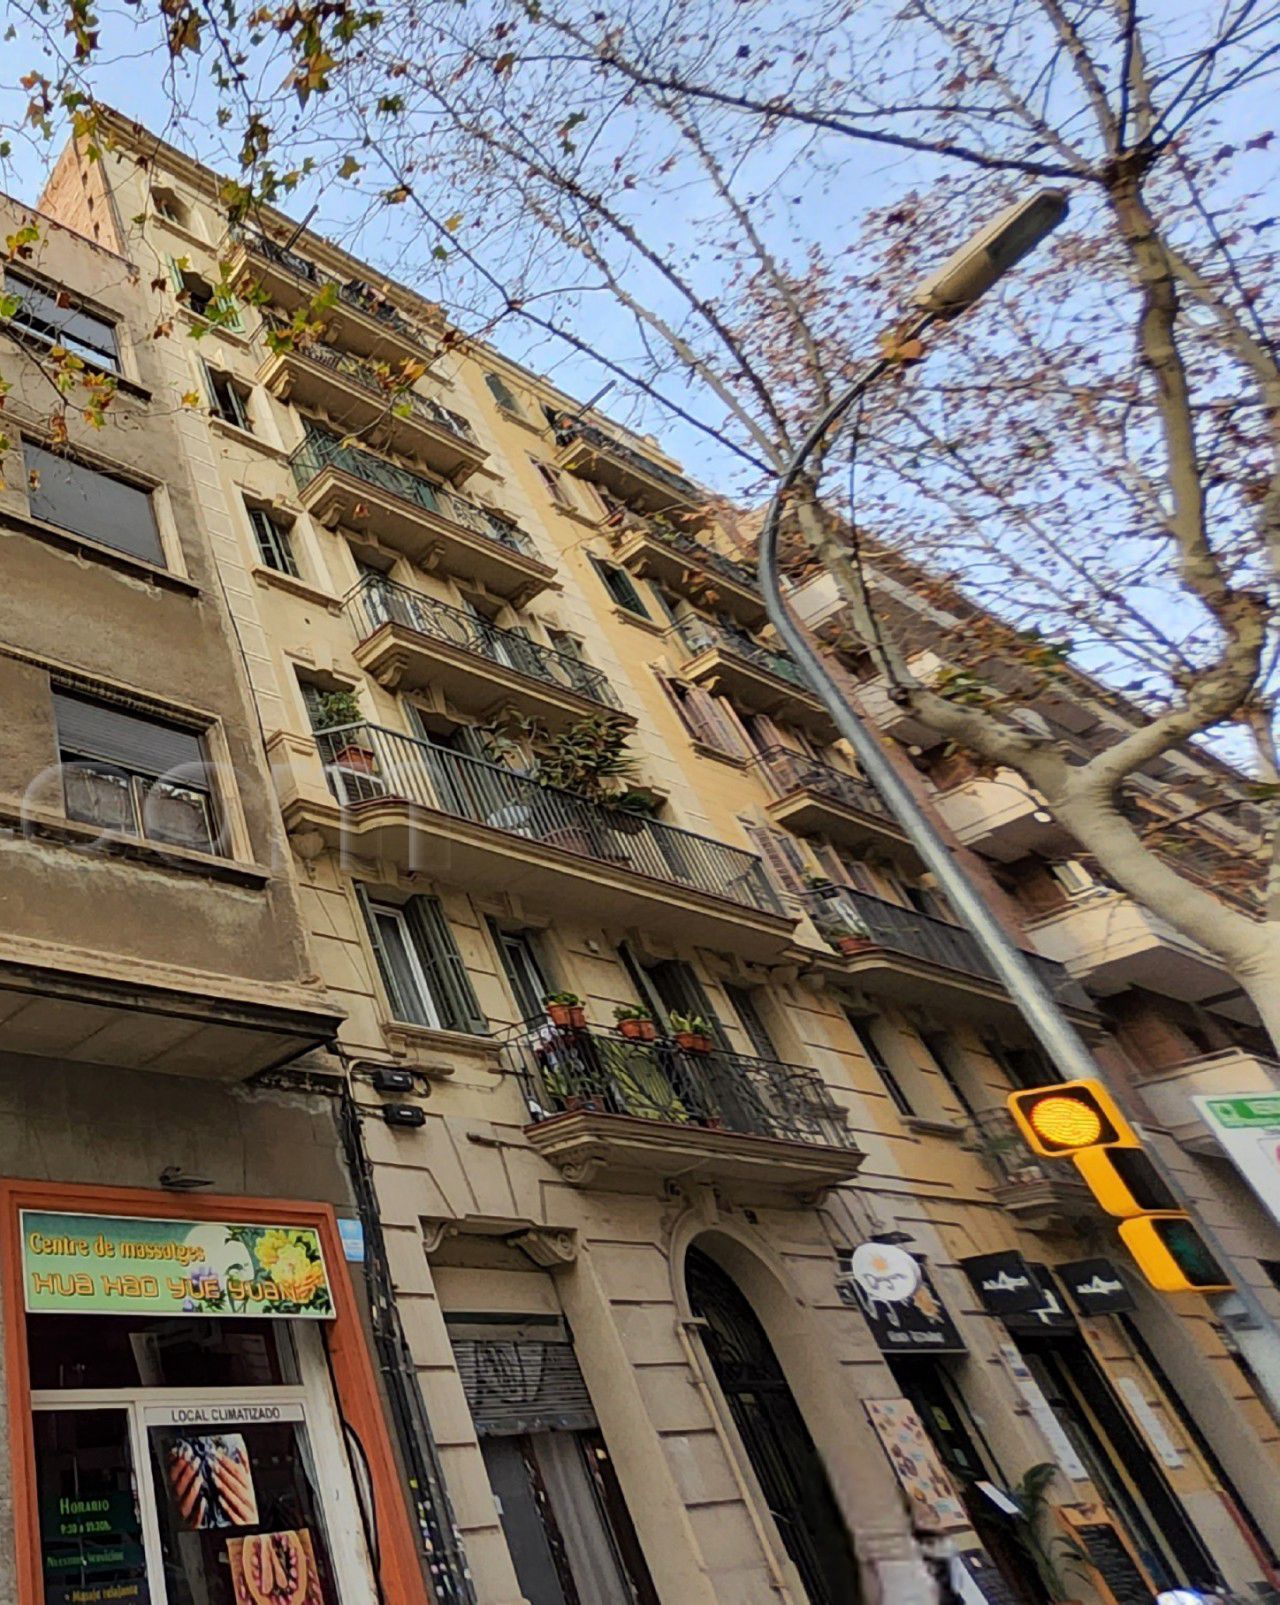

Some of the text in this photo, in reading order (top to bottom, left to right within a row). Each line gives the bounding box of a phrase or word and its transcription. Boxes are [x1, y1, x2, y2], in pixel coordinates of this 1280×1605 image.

[29, 1232, 206, 1266] Centre de massatges
[167, 1277, 221, 1301] YUE
[171, 1407, 281, 1423] LOCAL CLIMATIZADO
